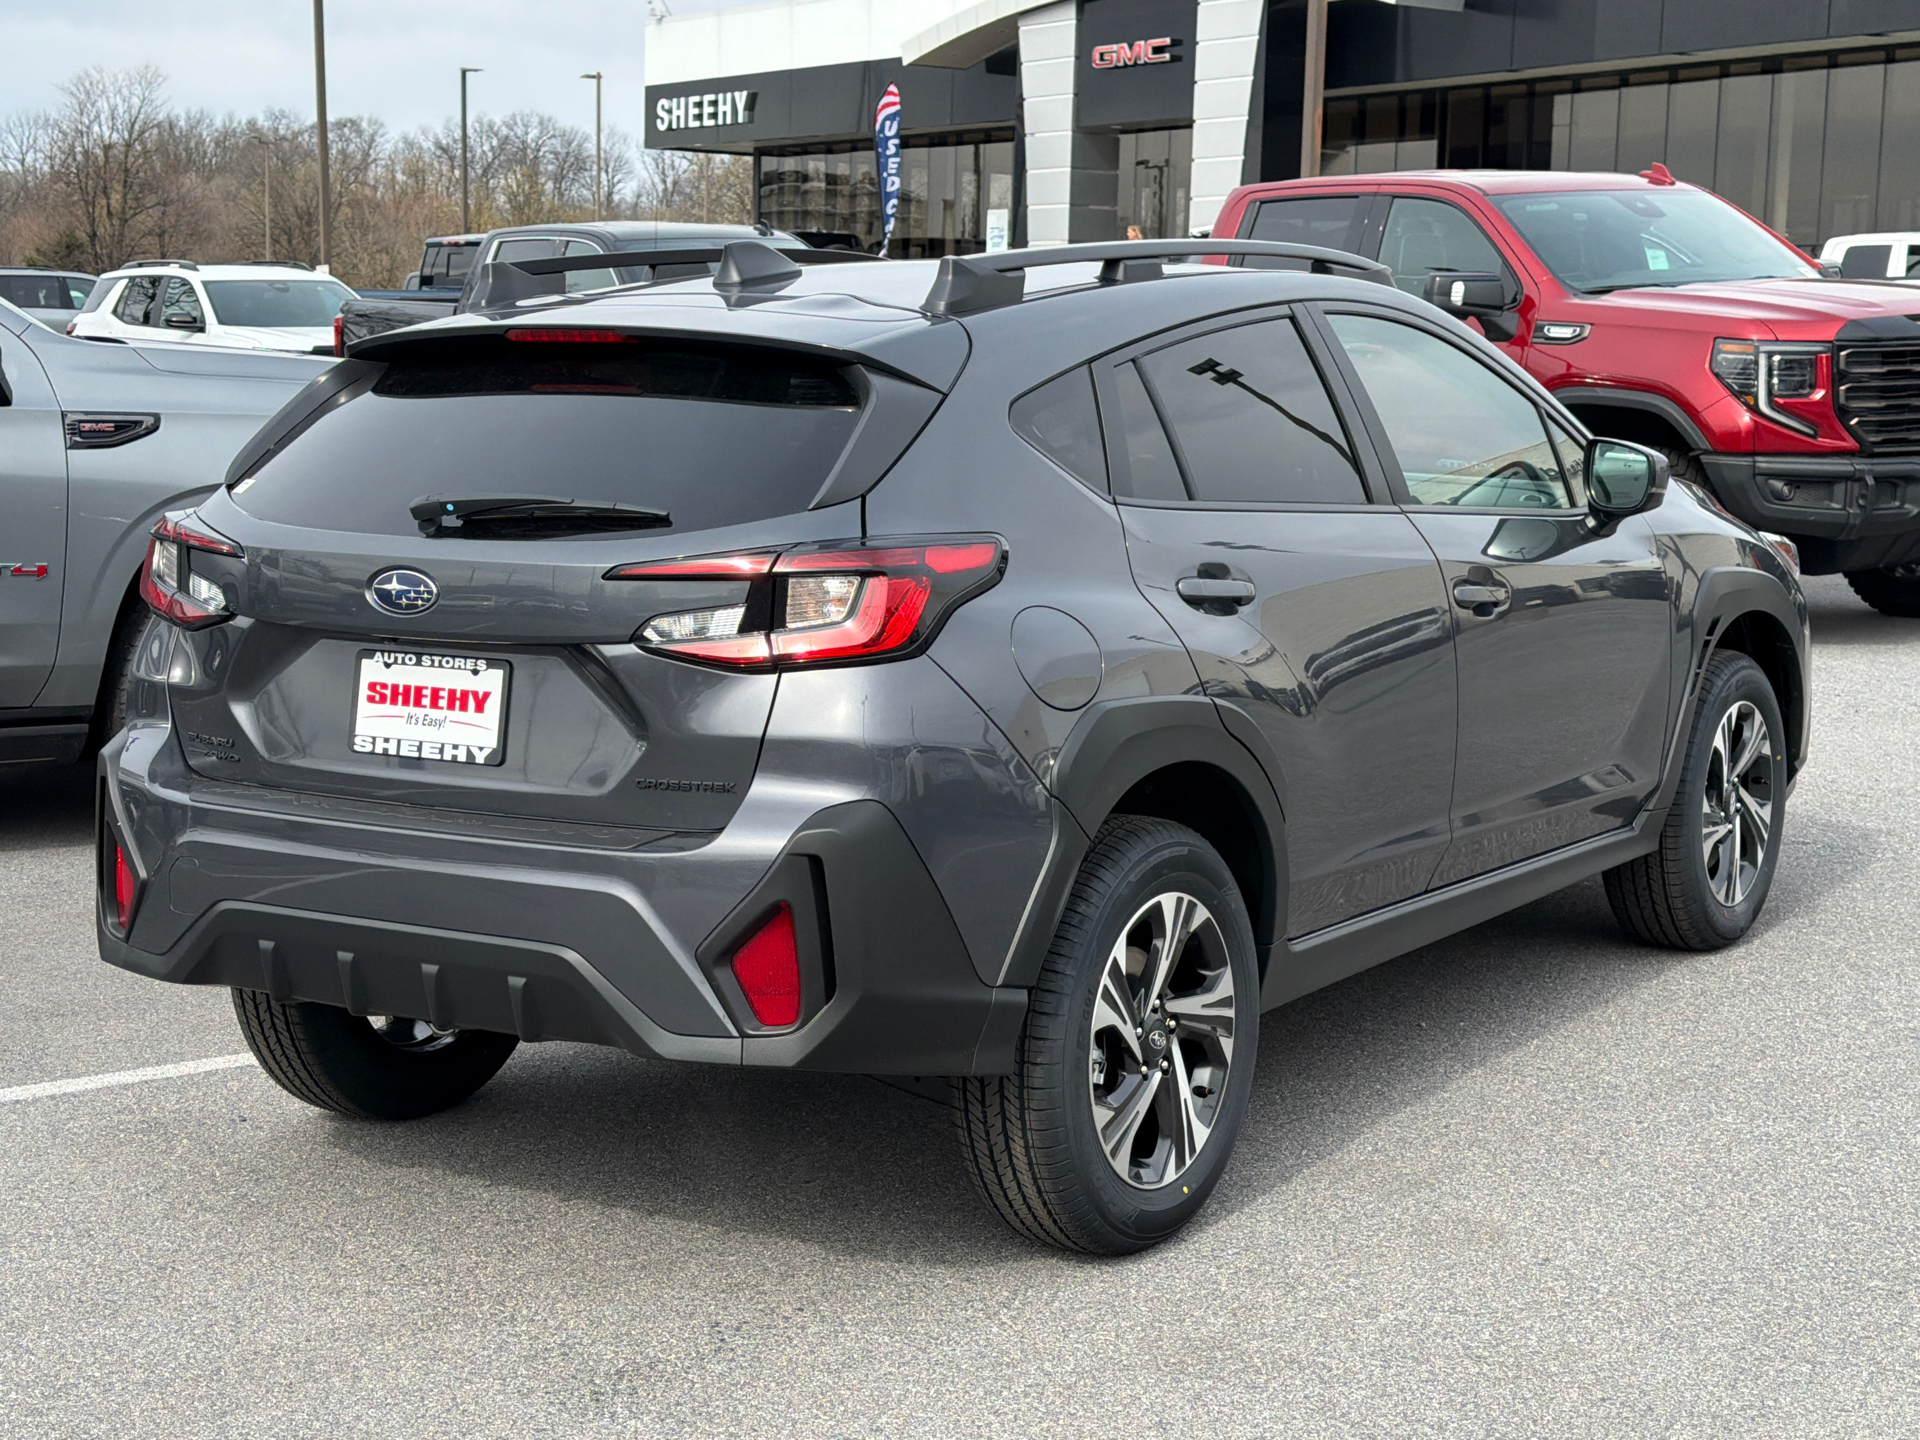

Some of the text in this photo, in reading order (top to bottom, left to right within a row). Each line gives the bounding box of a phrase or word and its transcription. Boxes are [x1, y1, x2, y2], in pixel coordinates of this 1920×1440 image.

[1092, 37, 1171, 68] GMC
[656, 90, 749, 131] SHEEHY
[884, 120, 900, 192] USED
[373, 652, 487, 671] AUTO STORES
[366, 681, 492, 714] SHEEHY
[406, 712, 447, 730] It's Easy!
[187, 731, 235, 747] SUBARU
[353, 735, 493, 764] SHEEHY
[636, 778, 737, 794] CROSSTREK
